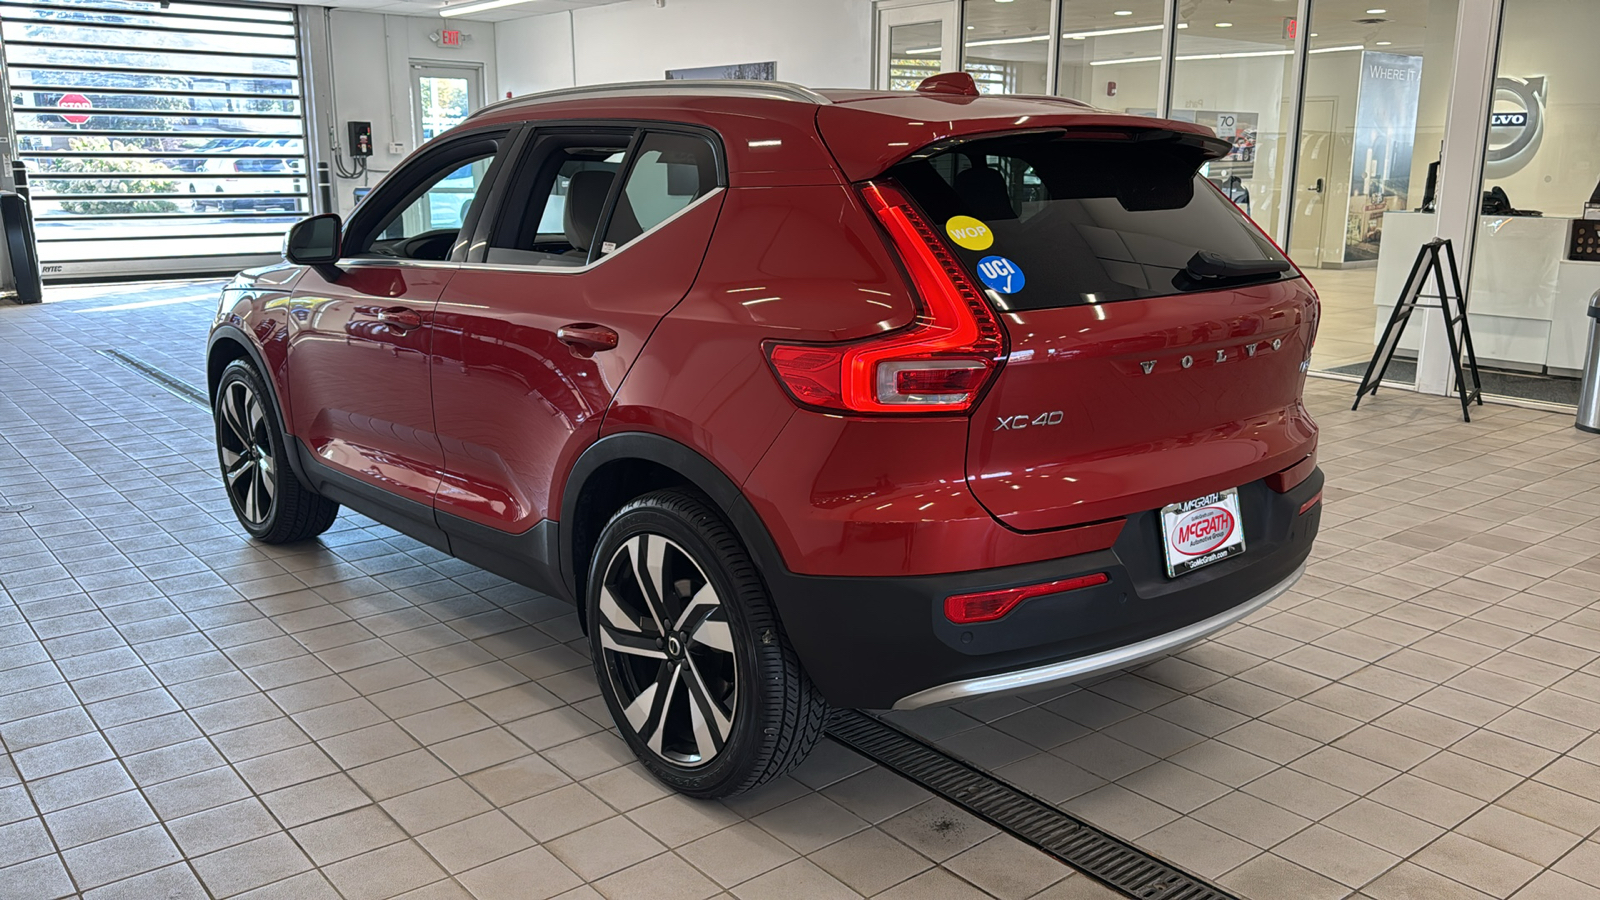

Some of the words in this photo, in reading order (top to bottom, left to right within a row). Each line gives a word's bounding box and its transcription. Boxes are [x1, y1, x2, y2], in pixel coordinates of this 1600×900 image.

[442, 30, 459, 45] EXIT
[1370, 65, 1406, 81] WHERE
[1220, 115, 1235, 127] 70
[1492, 114, 1525, 125] LVO
[950, 226, 987, 240] WOP
[42, 265, 62, 273] RYTEC
[979, 258, 1016, 279] UCI
[1140, 338, 1282, 375] VOLVO
[993, 410, 1064, 431] XC40
[1190, 535, 1212, 547] Automotive
[1212, 531, 1225, 540] Group
